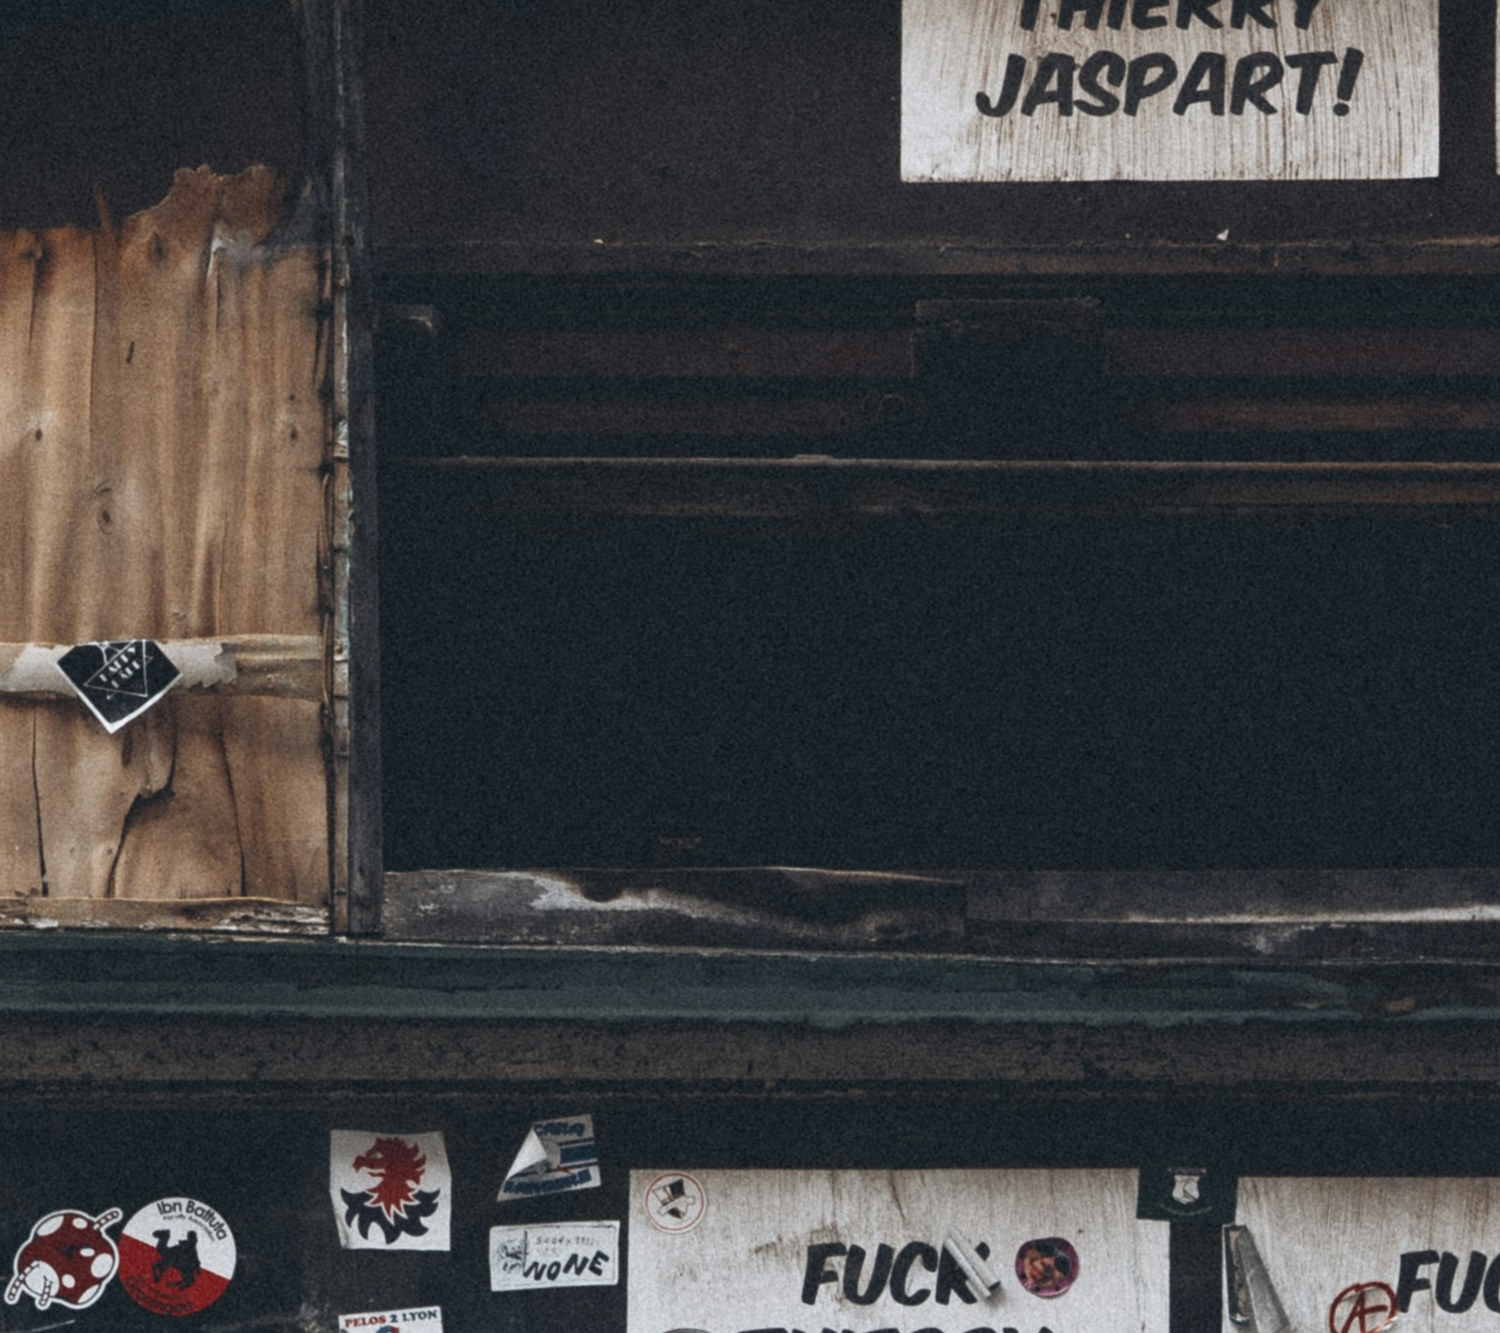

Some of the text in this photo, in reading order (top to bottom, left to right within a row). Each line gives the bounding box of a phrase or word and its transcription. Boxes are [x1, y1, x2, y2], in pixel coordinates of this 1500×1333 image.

[975, 48, 1365, 118] JASPART!
[800, 1241, 992, 1306] FUCK
[344, 1310, 438, 1328] PELOS 2 LYON
